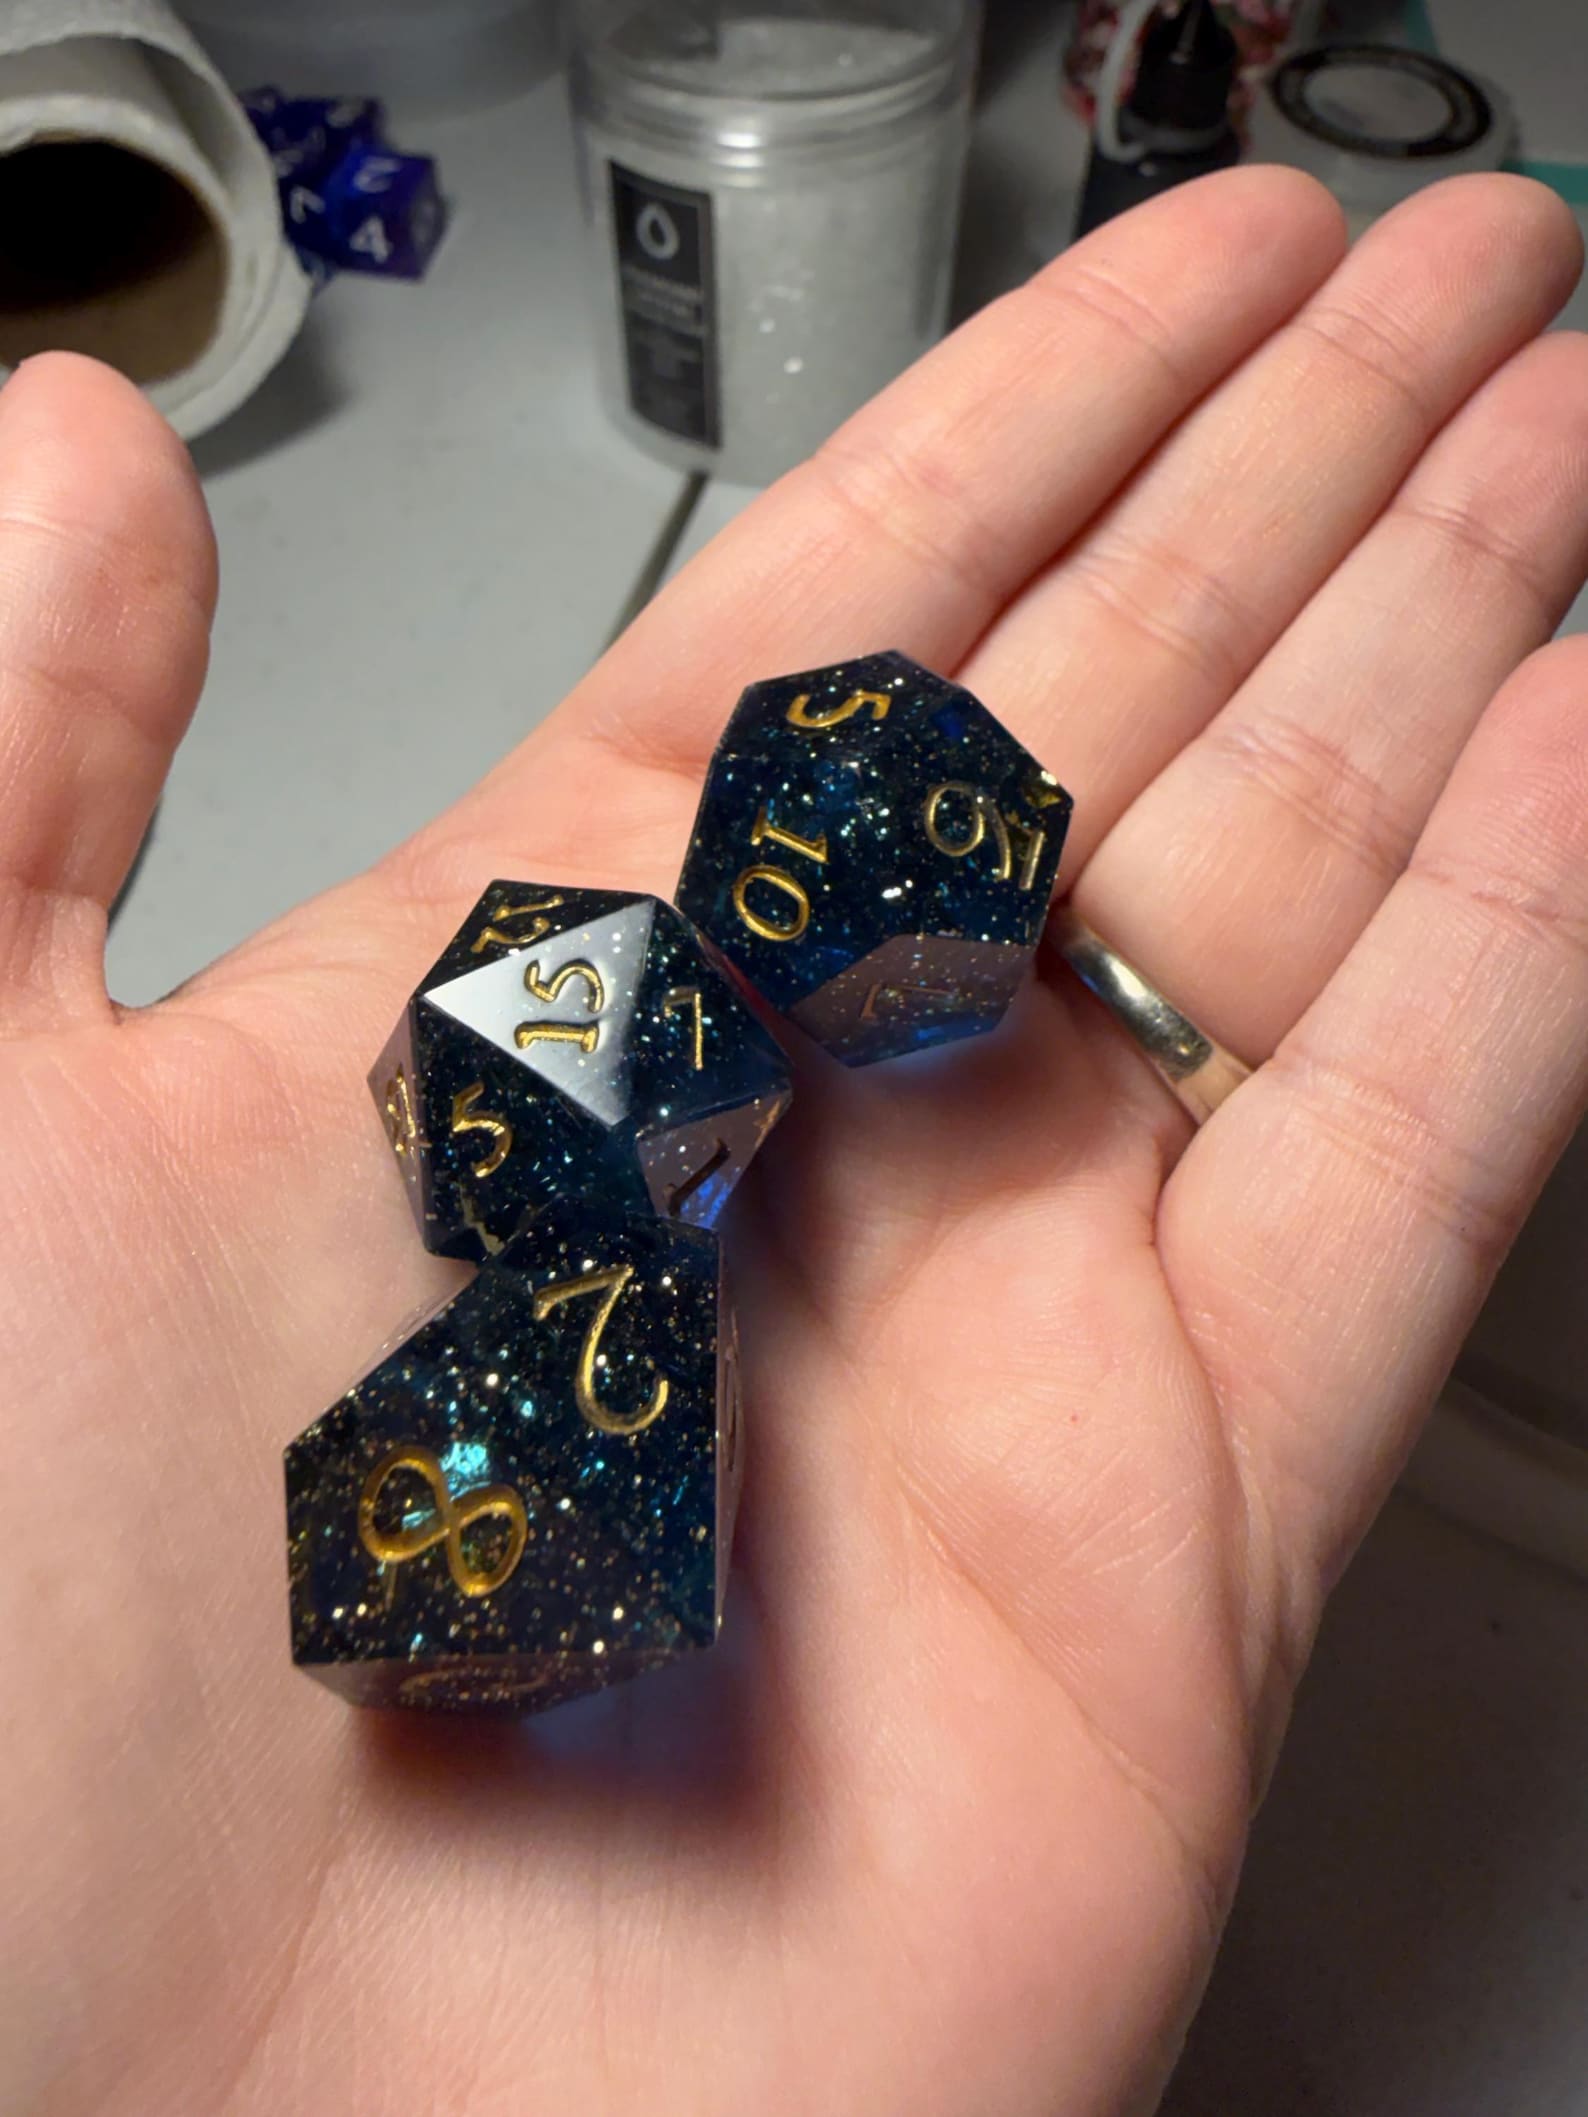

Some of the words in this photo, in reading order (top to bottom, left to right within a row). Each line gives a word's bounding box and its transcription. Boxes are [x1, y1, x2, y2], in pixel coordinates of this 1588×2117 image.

[732, 806, 829, 943] 10
[513, 957, 605, 1054] 15
[662, 985, 704, 1072] 7
[452, 1082, 514, 1179] 5
[533, 1263, 670, 1436] 2
[357, 1444, 528, 1599] 8
